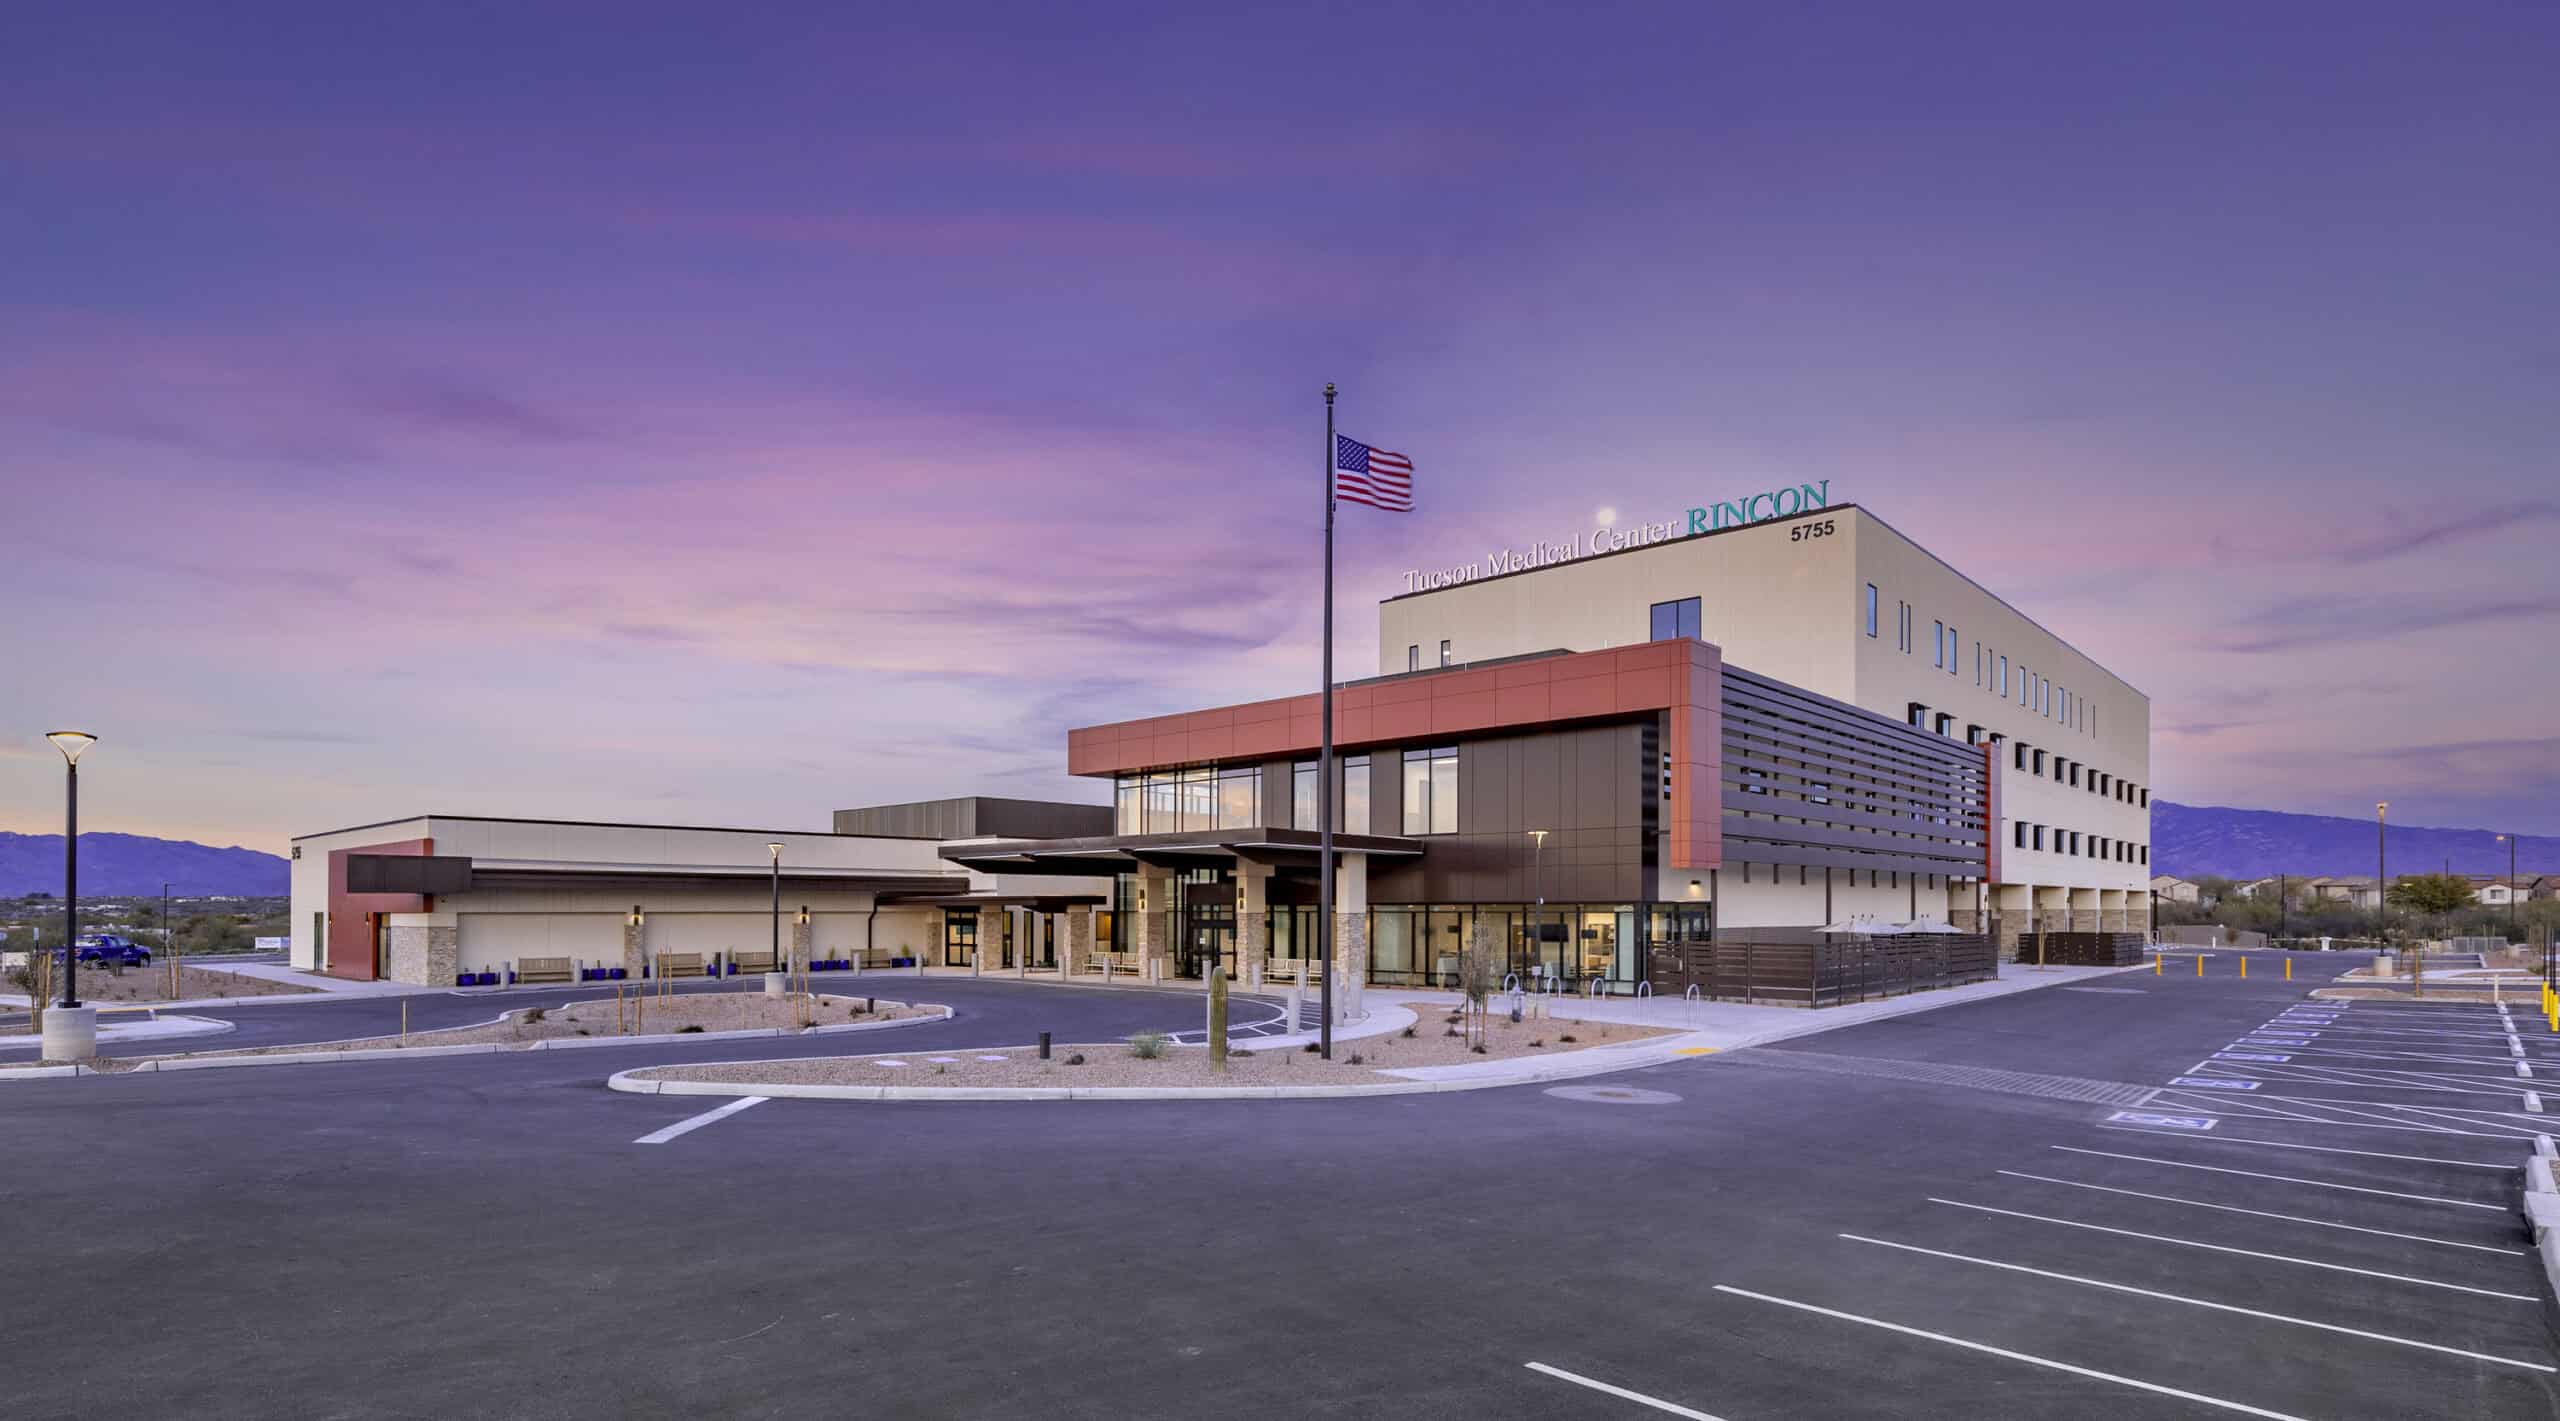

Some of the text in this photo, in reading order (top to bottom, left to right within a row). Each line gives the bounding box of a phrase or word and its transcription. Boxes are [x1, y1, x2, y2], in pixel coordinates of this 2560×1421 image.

[1403, 479, 1830, 594] Tucson Medical Center RINCON
[1791, 519, 1836, 542] 5755
